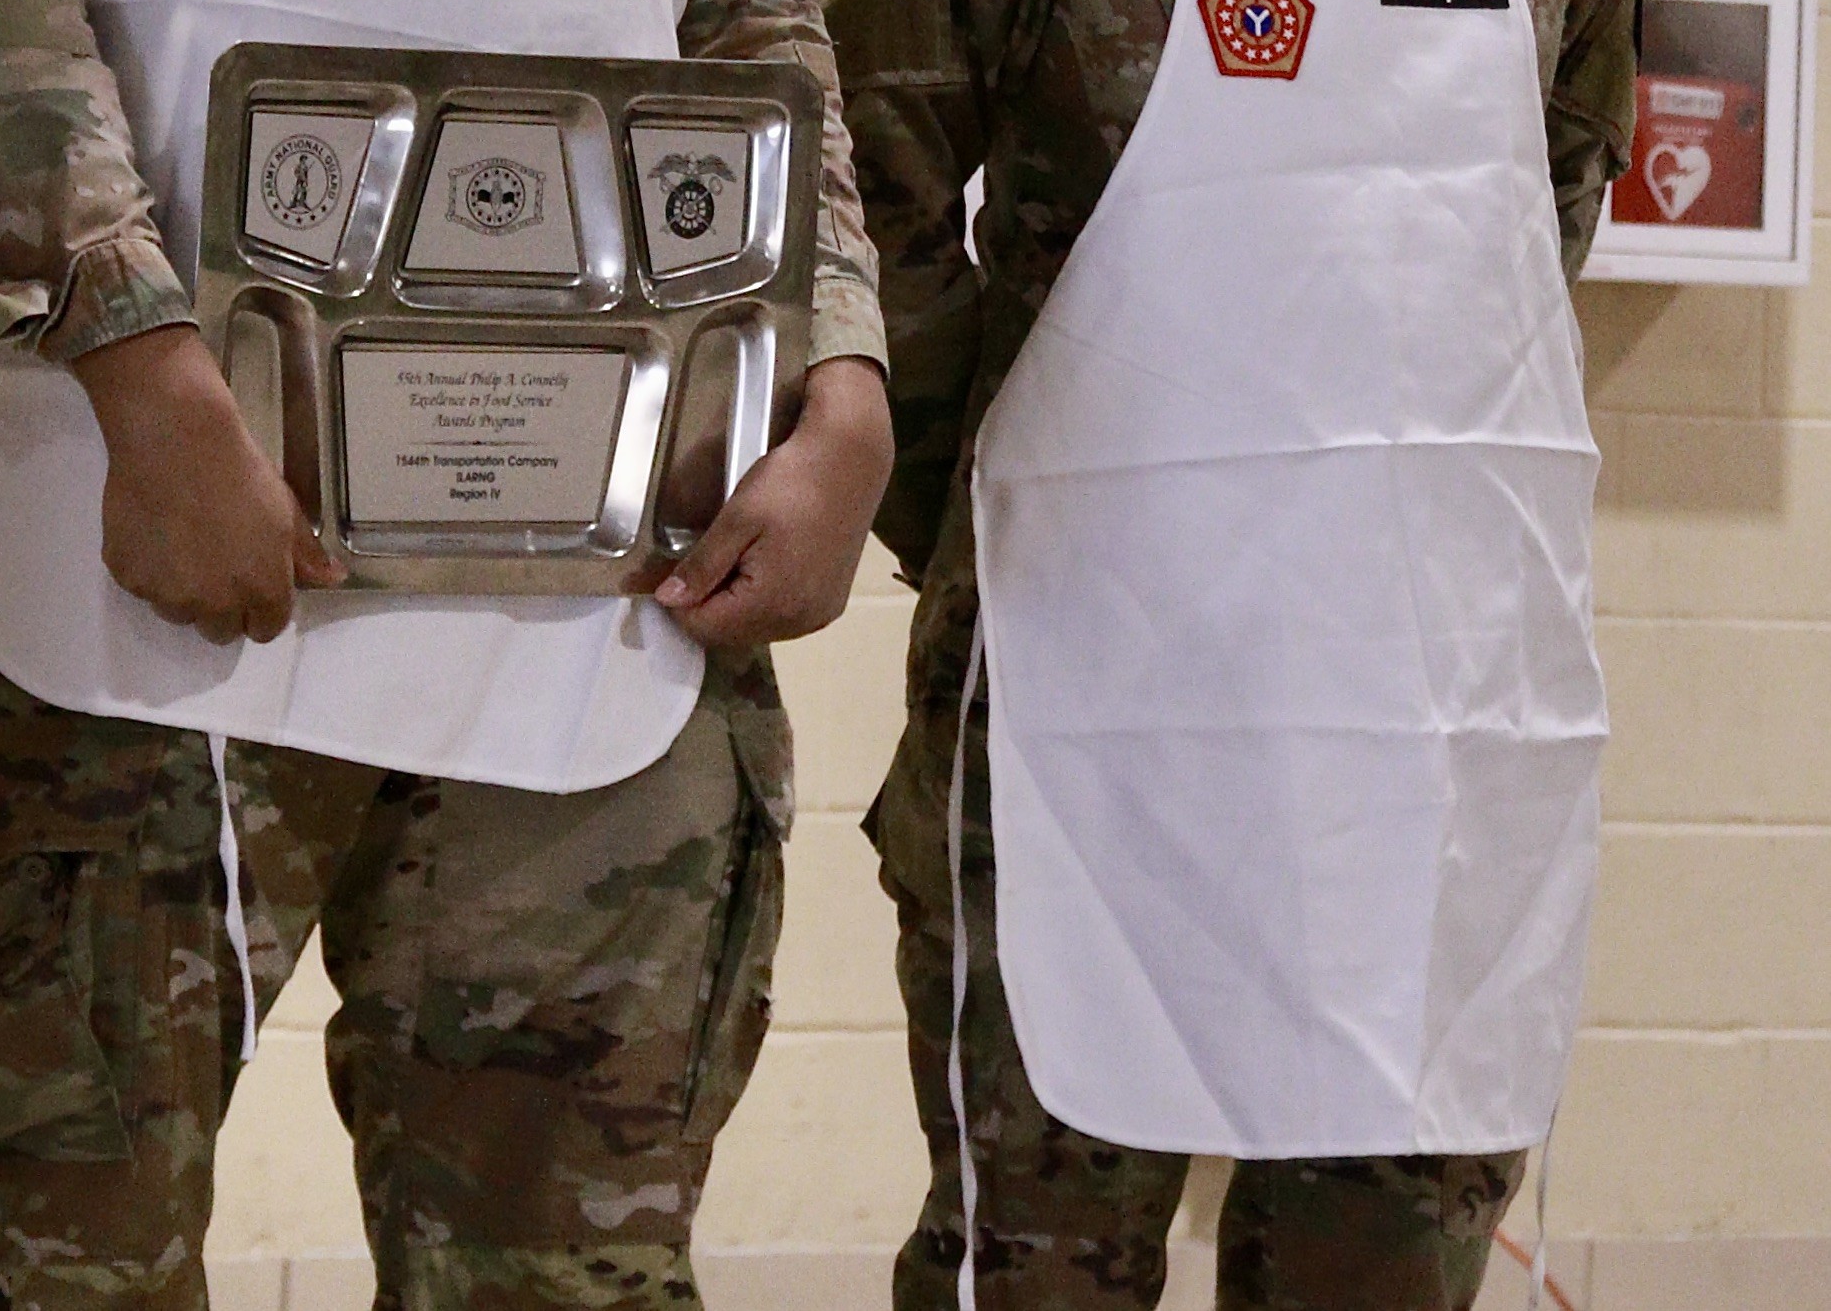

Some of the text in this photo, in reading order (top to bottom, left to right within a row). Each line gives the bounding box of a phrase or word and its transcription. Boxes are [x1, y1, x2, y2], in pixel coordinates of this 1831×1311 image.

[274, 139, 325, 162] NATIONAL
[433, 454, 505, 469] Transportation
[507, 455, 559, 470] Company
